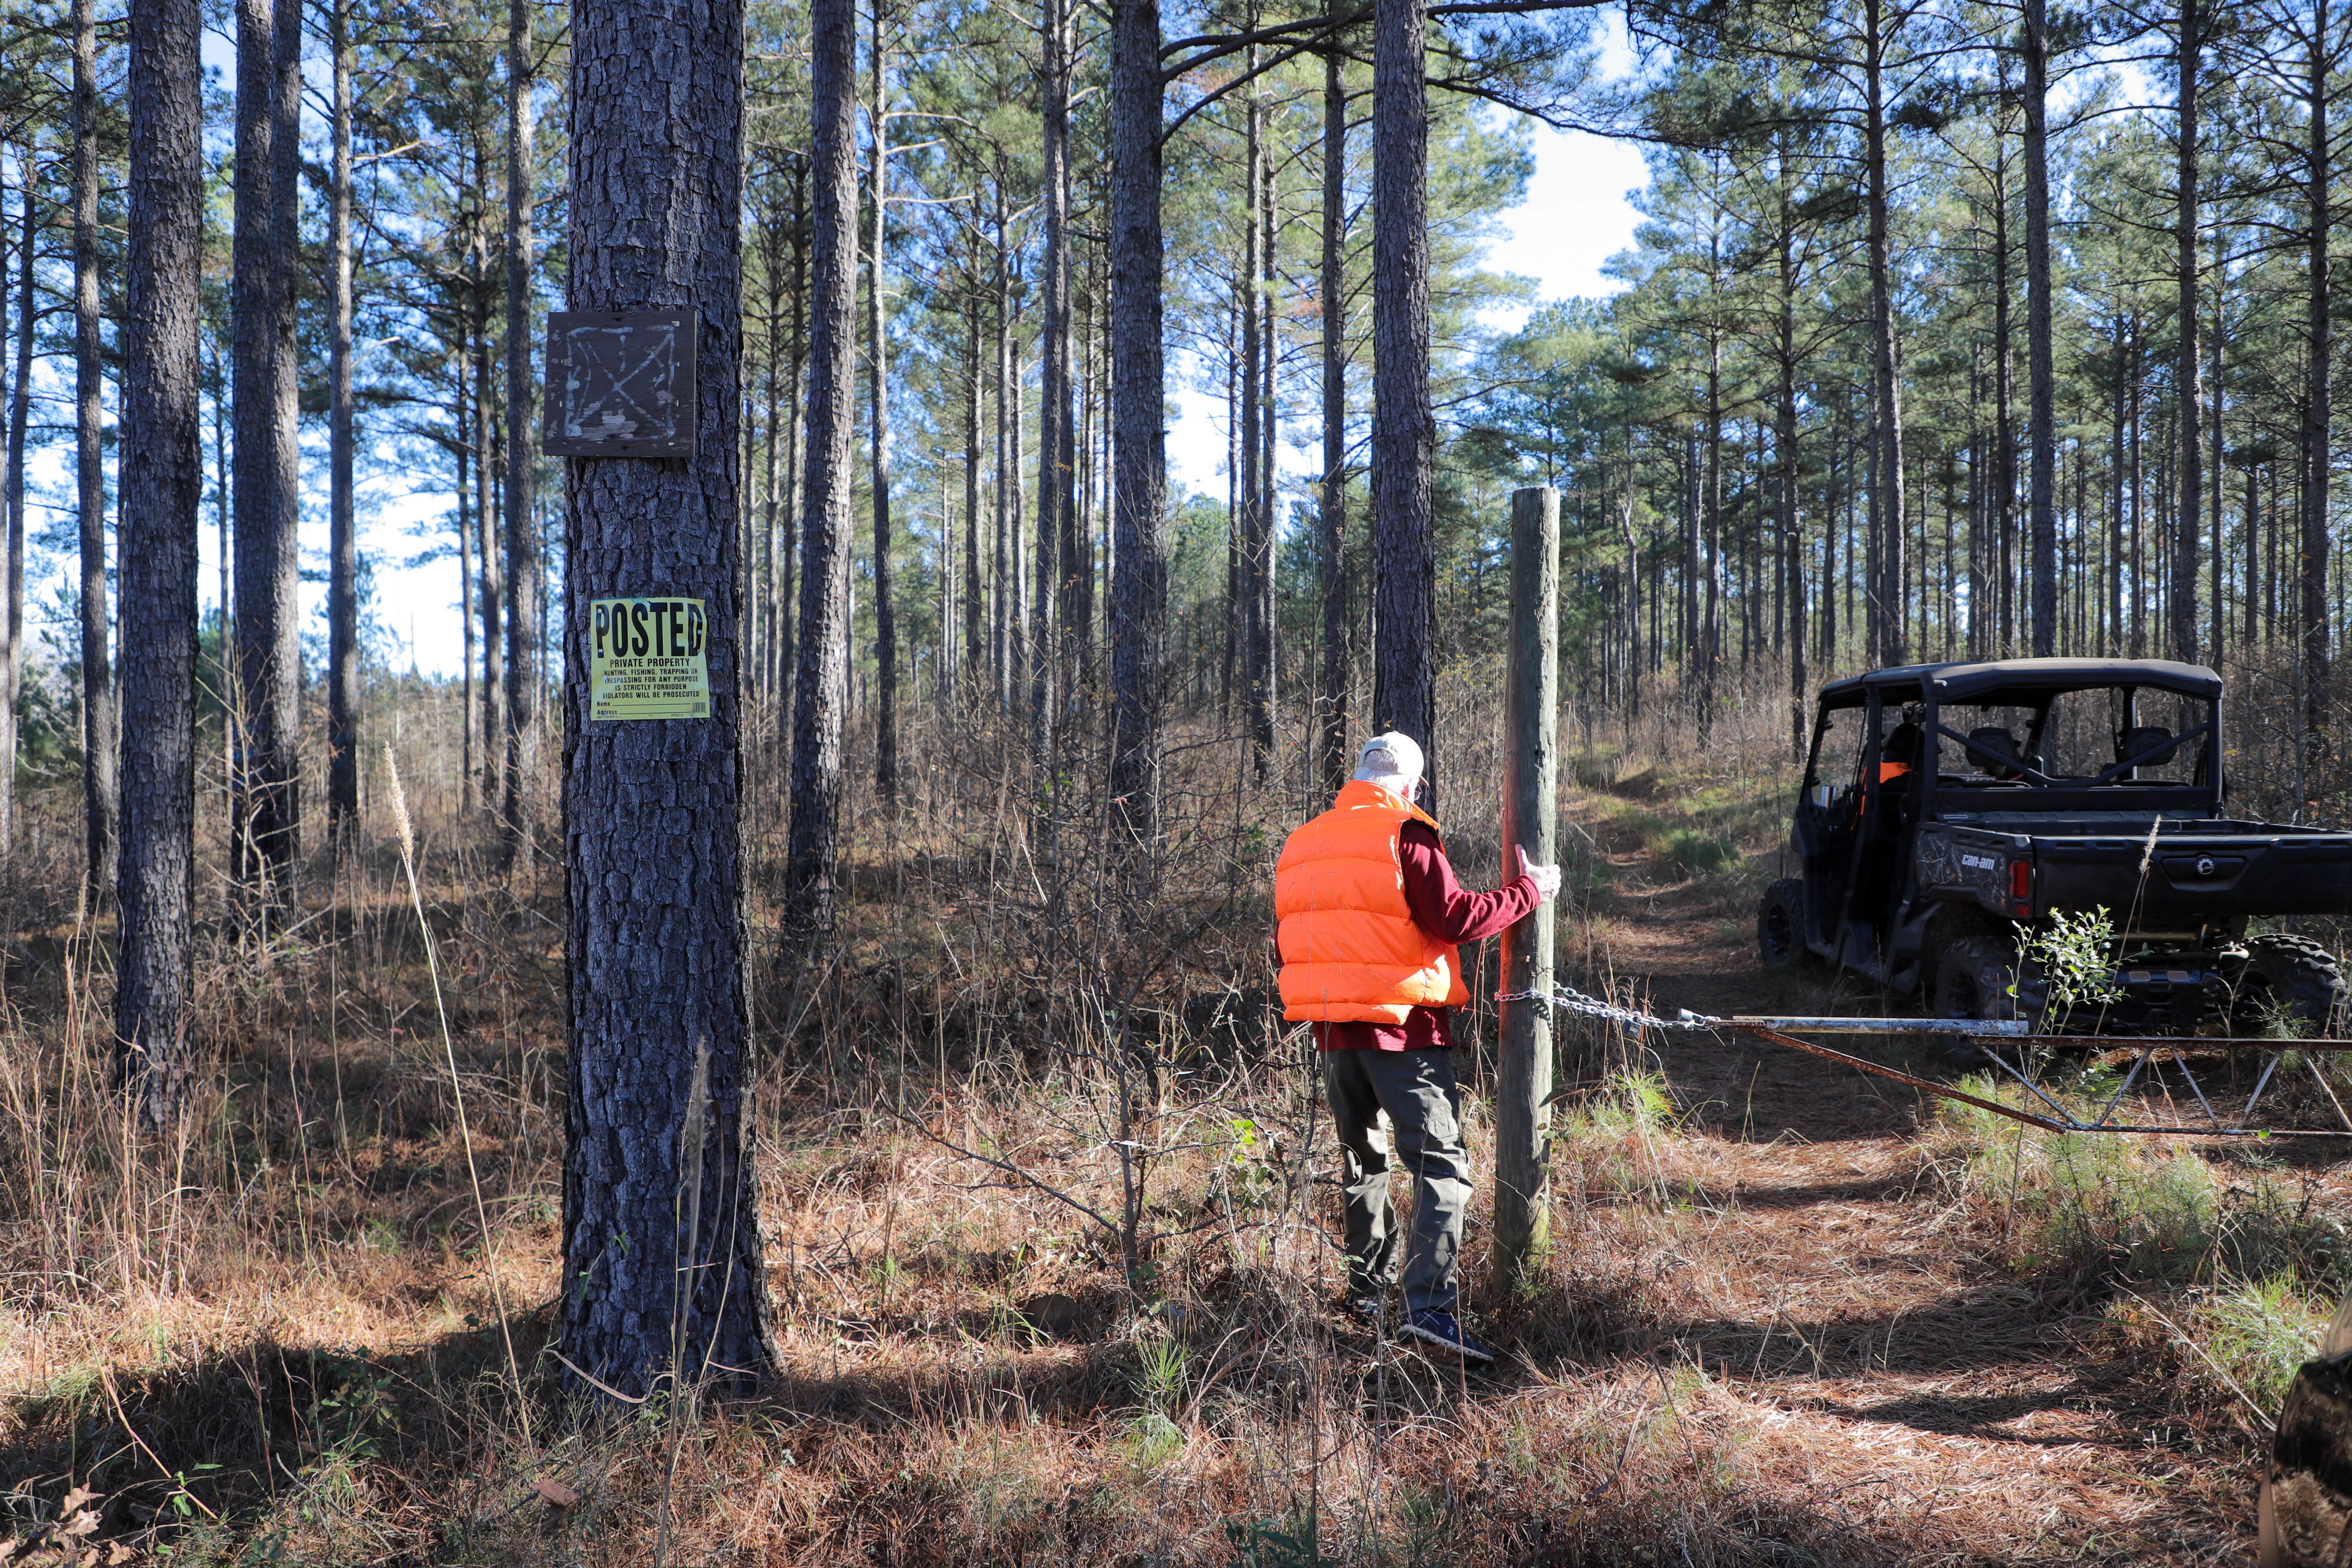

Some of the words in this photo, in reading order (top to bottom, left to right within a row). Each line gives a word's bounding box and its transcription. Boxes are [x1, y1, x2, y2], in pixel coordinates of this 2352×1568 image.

[596, 602, 702, 659] POSTED
[610, 659, 643, 668] PRIVATE
[648, 658, 689, 667] PROPERTY
[1962, 854, 1995, 870] can-am
